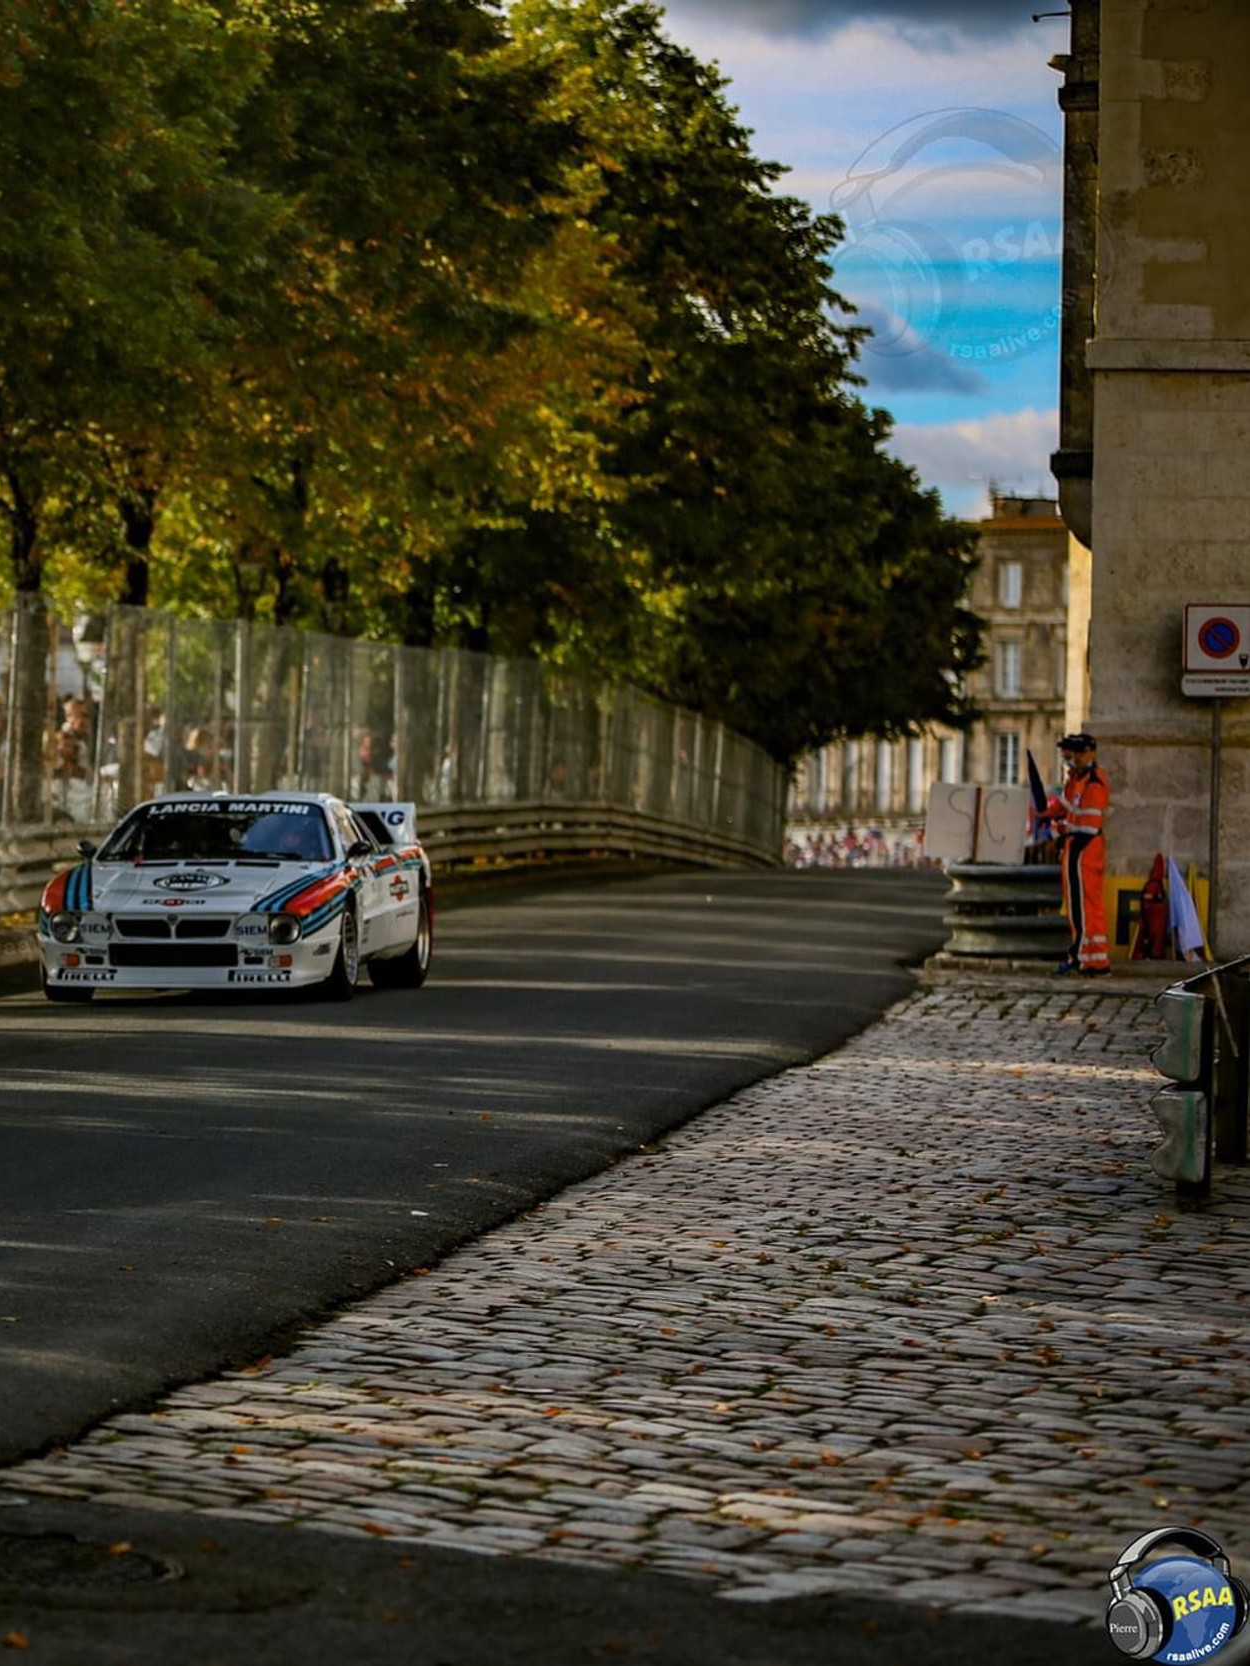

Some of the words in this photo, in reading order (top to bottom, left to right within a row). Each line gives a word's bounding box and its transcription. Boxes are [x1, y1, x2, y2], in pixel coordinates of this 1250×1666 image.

[148, 803, 221, 815] LANCIA
[227, 803, 310, 815] MARTINI
[57, 967, 119, 981] PIRELLI
[228, 969, 292, 983] PIRELLI
